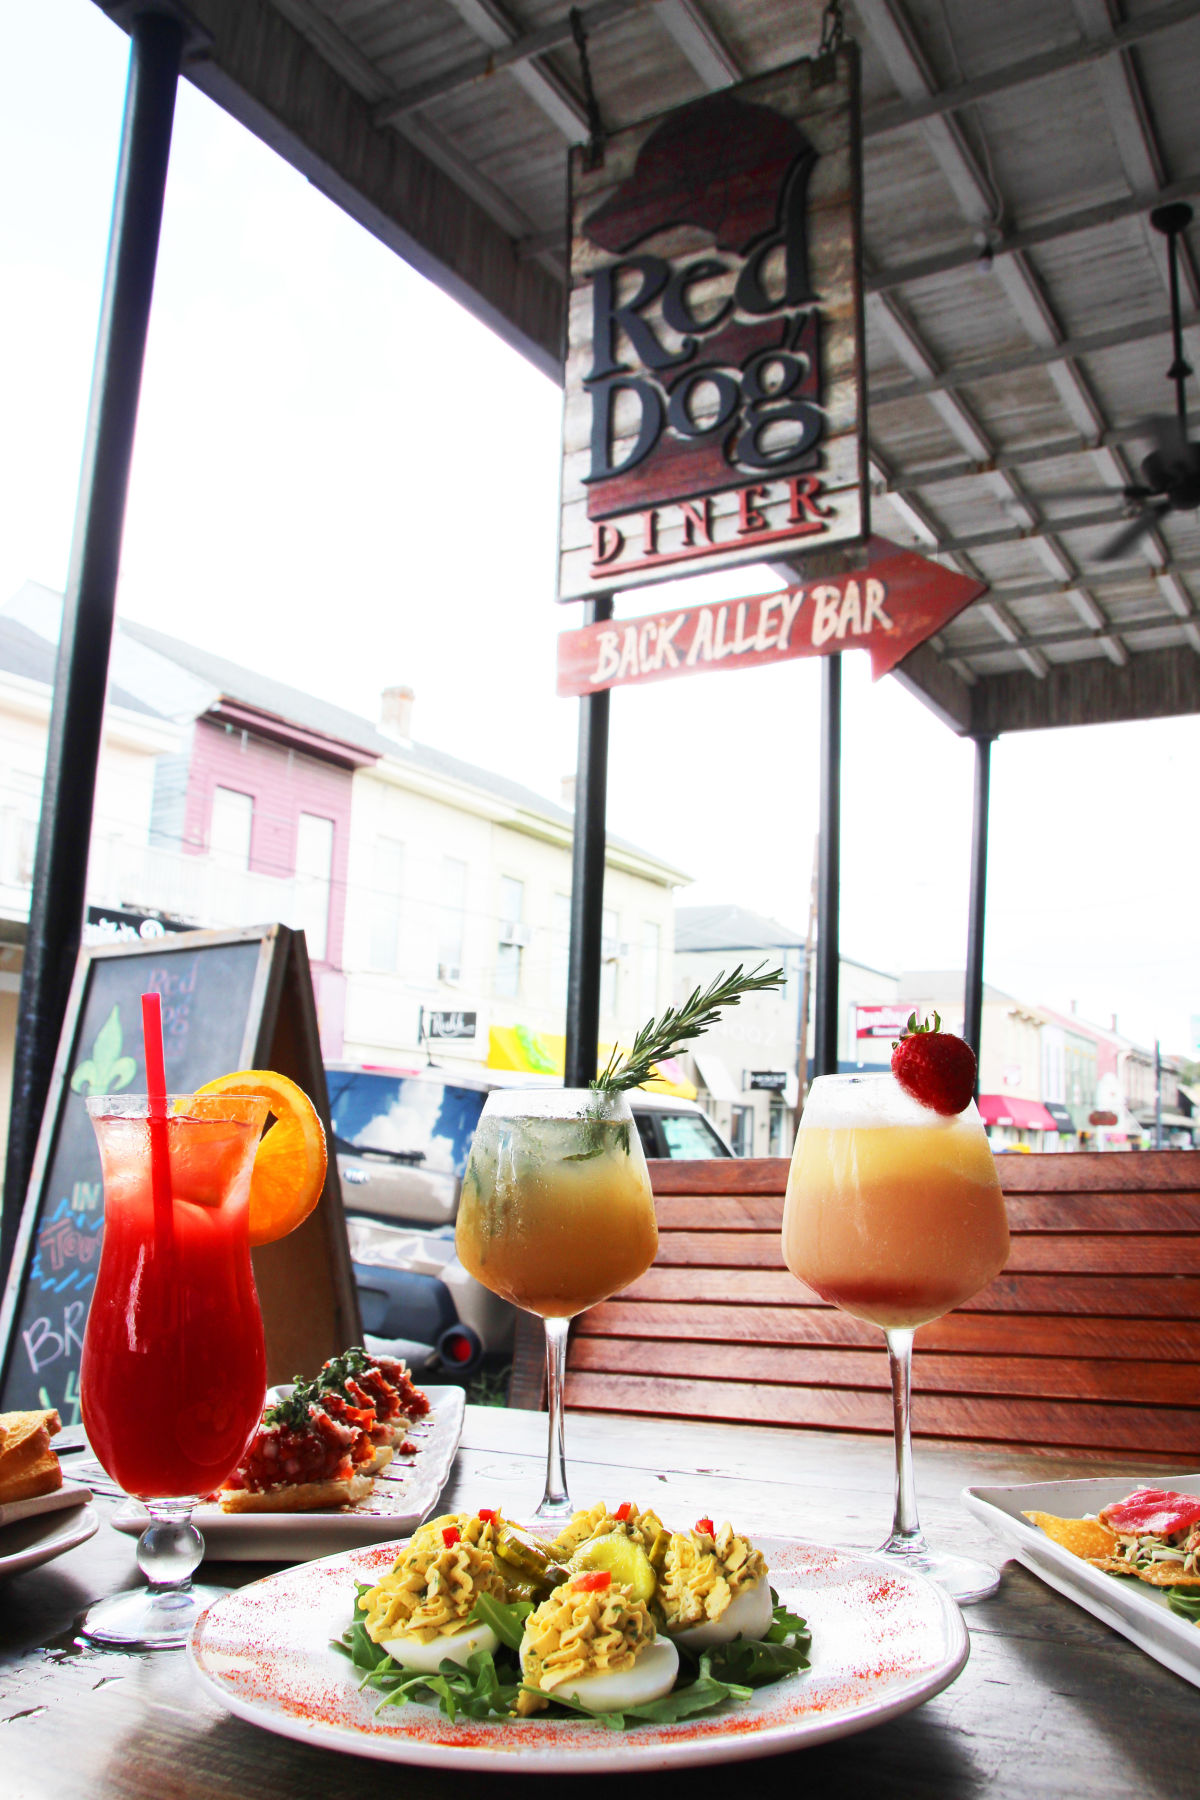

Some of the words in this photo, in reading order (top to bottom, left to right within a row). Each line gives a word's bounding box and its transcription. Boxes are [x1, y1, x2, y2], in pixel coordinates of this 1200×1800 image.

[583, 145, 822, 383] Red
[581, 312, 828, 484] Dog
[591, 477, 832, 566] DINER
[589, 613, 687, 684] BACK
[686, 590, 804, 667] ALLEY
[811, 578, 894, 648] BAR
